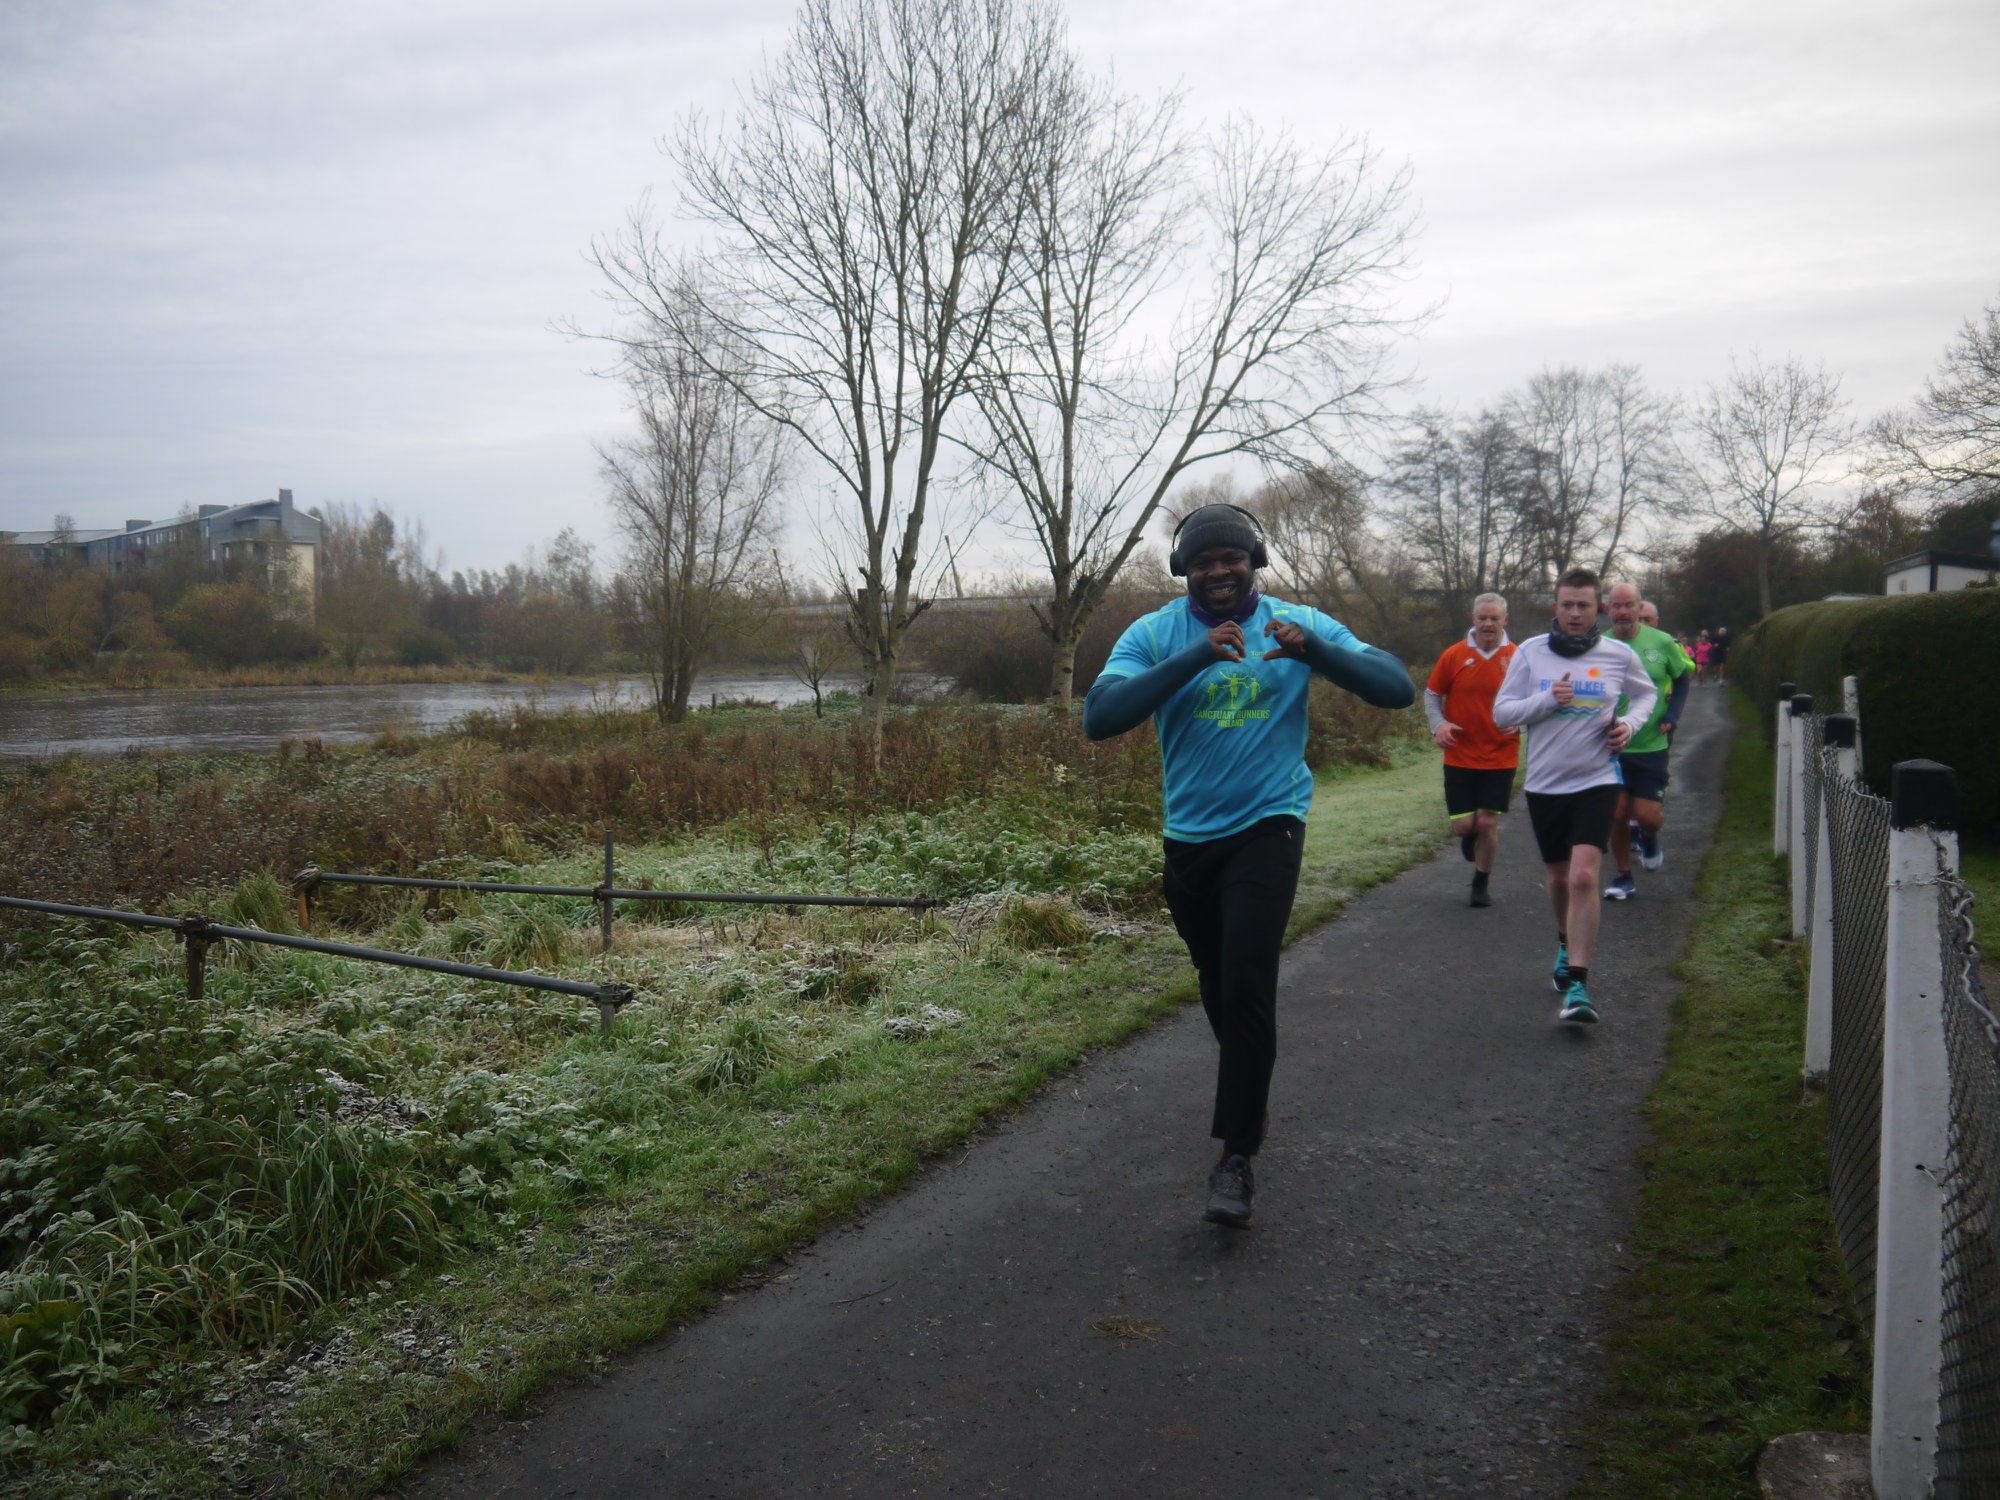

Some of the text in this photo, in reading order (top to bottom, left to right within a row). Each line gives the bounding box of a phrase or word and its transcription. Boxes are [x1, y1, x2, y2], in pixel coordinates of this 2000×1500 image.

[1570, 679, 1606, 696] ILKEE
[1193, 709, 1271, 720] SANCTUARY RUNNERS
[1217, 719, 1245, 728] IRELAND
